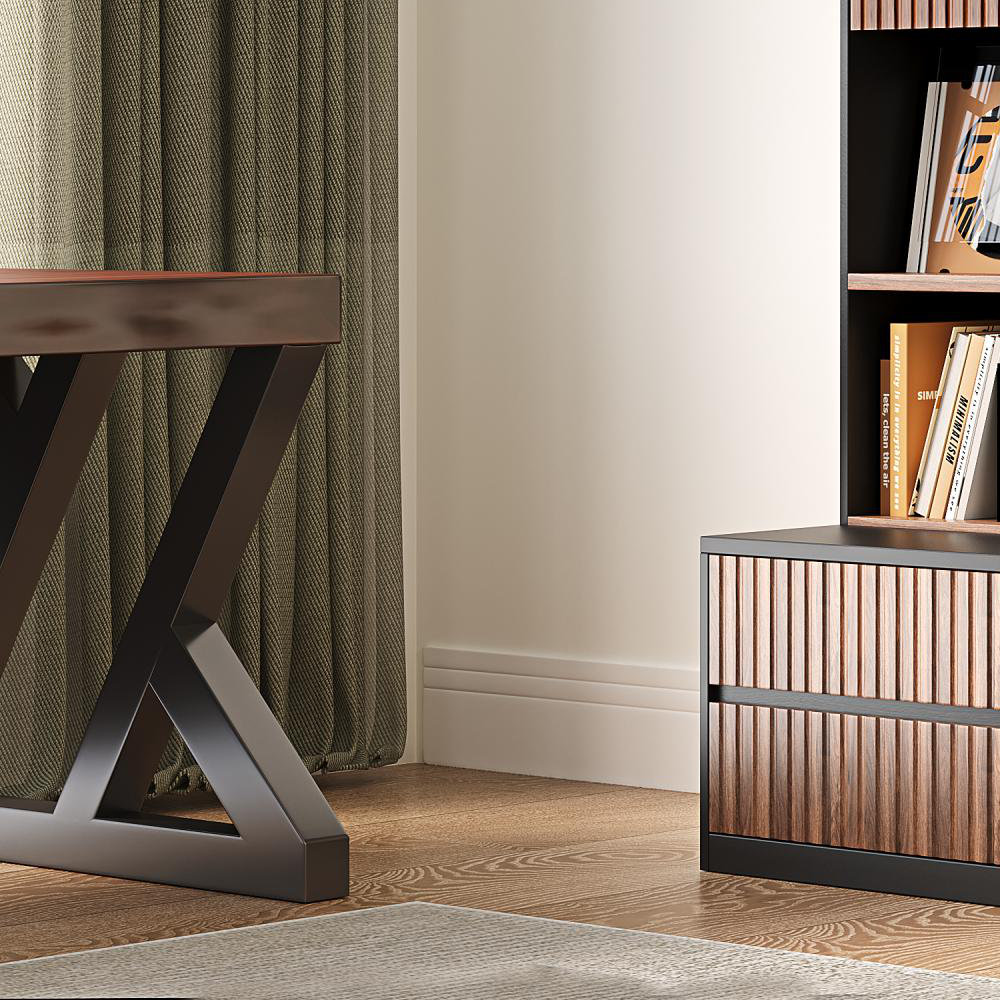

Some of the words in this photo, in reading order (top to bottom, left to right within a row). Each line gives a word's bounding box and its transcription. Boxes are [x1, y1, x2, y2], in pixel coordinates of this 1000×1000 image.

[975, 347, 989, 396] simplicity
[882, 393, 890, 416] lets,
[882, 419, 890, 449] clean
[892, 416, 900, 473] everything
[945, 395, 969, 465] MINIMALISM
[882, 452, 890, 470] the
[882, 472, 890, 488] air
